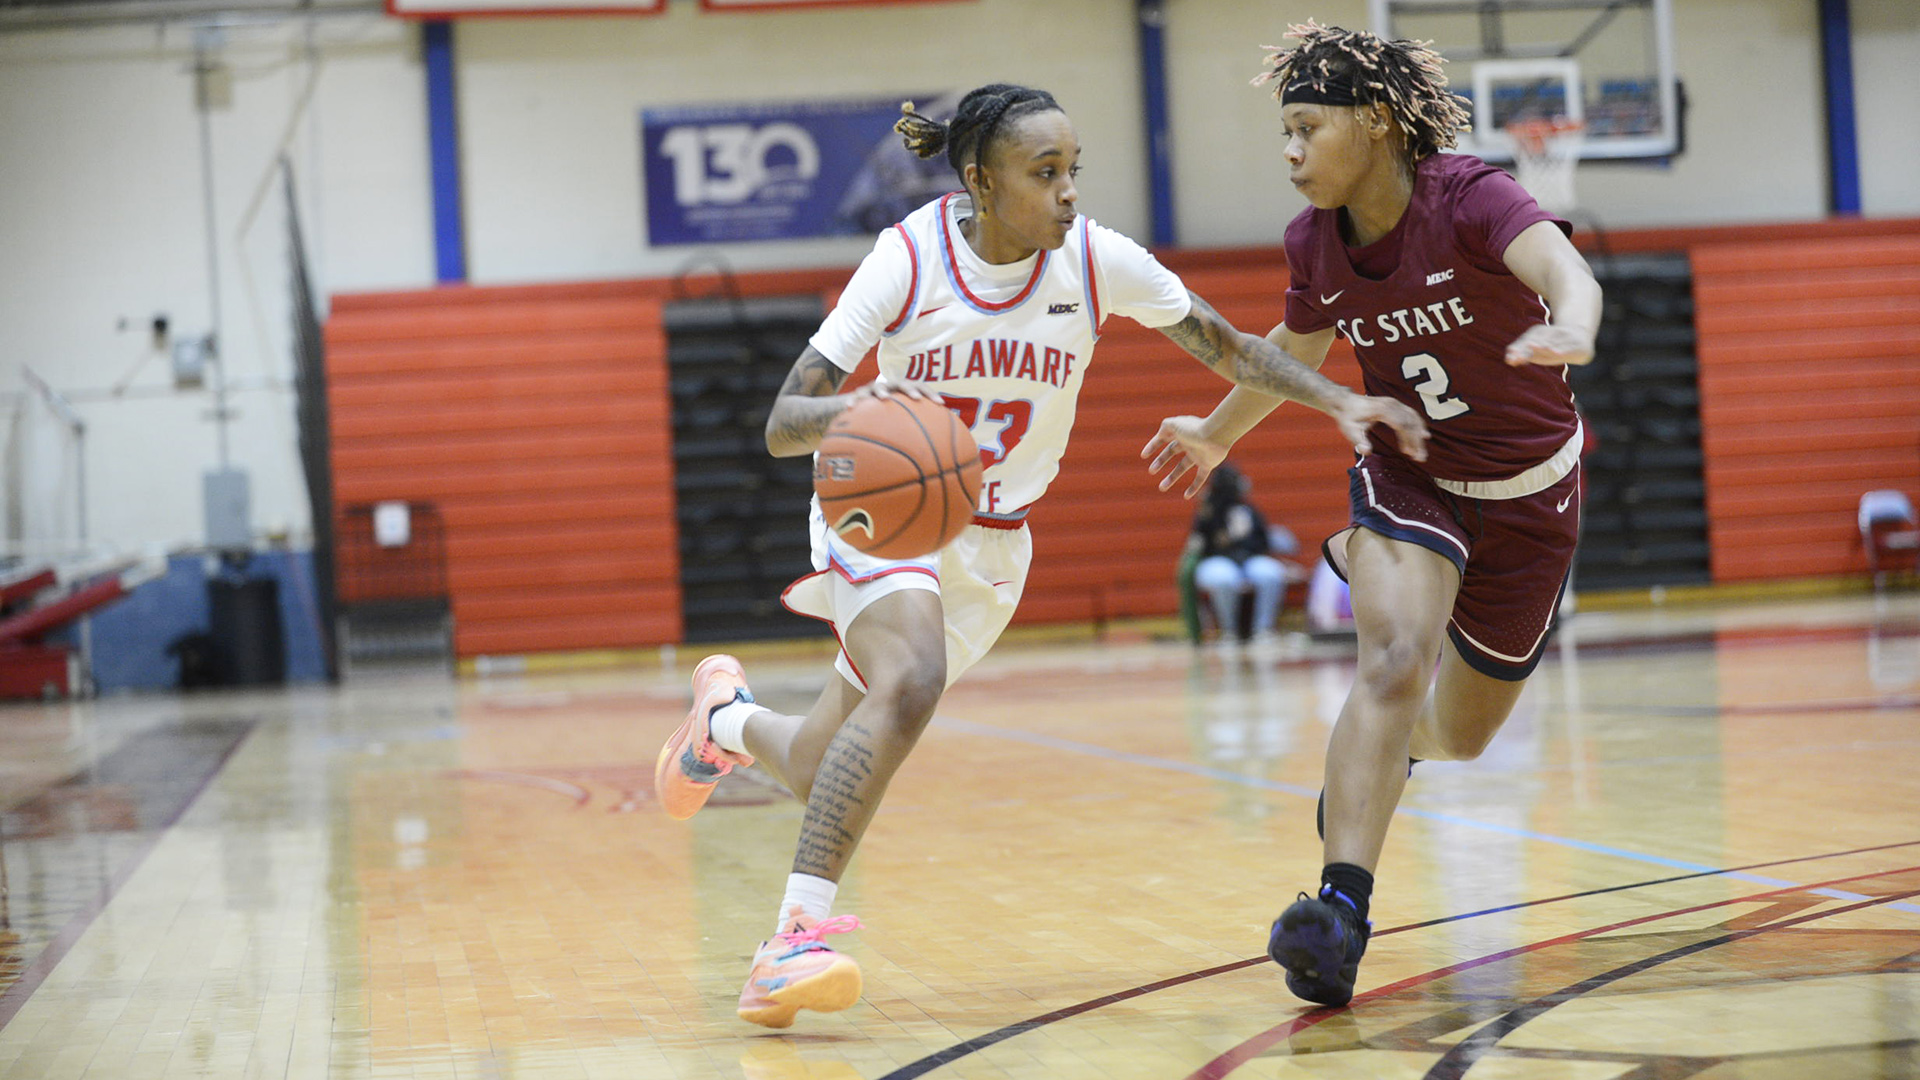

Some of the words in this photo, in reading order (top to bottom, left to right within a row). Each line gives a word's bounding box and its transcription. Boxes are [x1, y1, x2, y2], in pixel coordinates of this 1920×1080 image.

[1426, 268, 1454, 286] MEAC
[1377, 297, 1474, 343] STATE
[1401, 352, 1470, 421] 2
